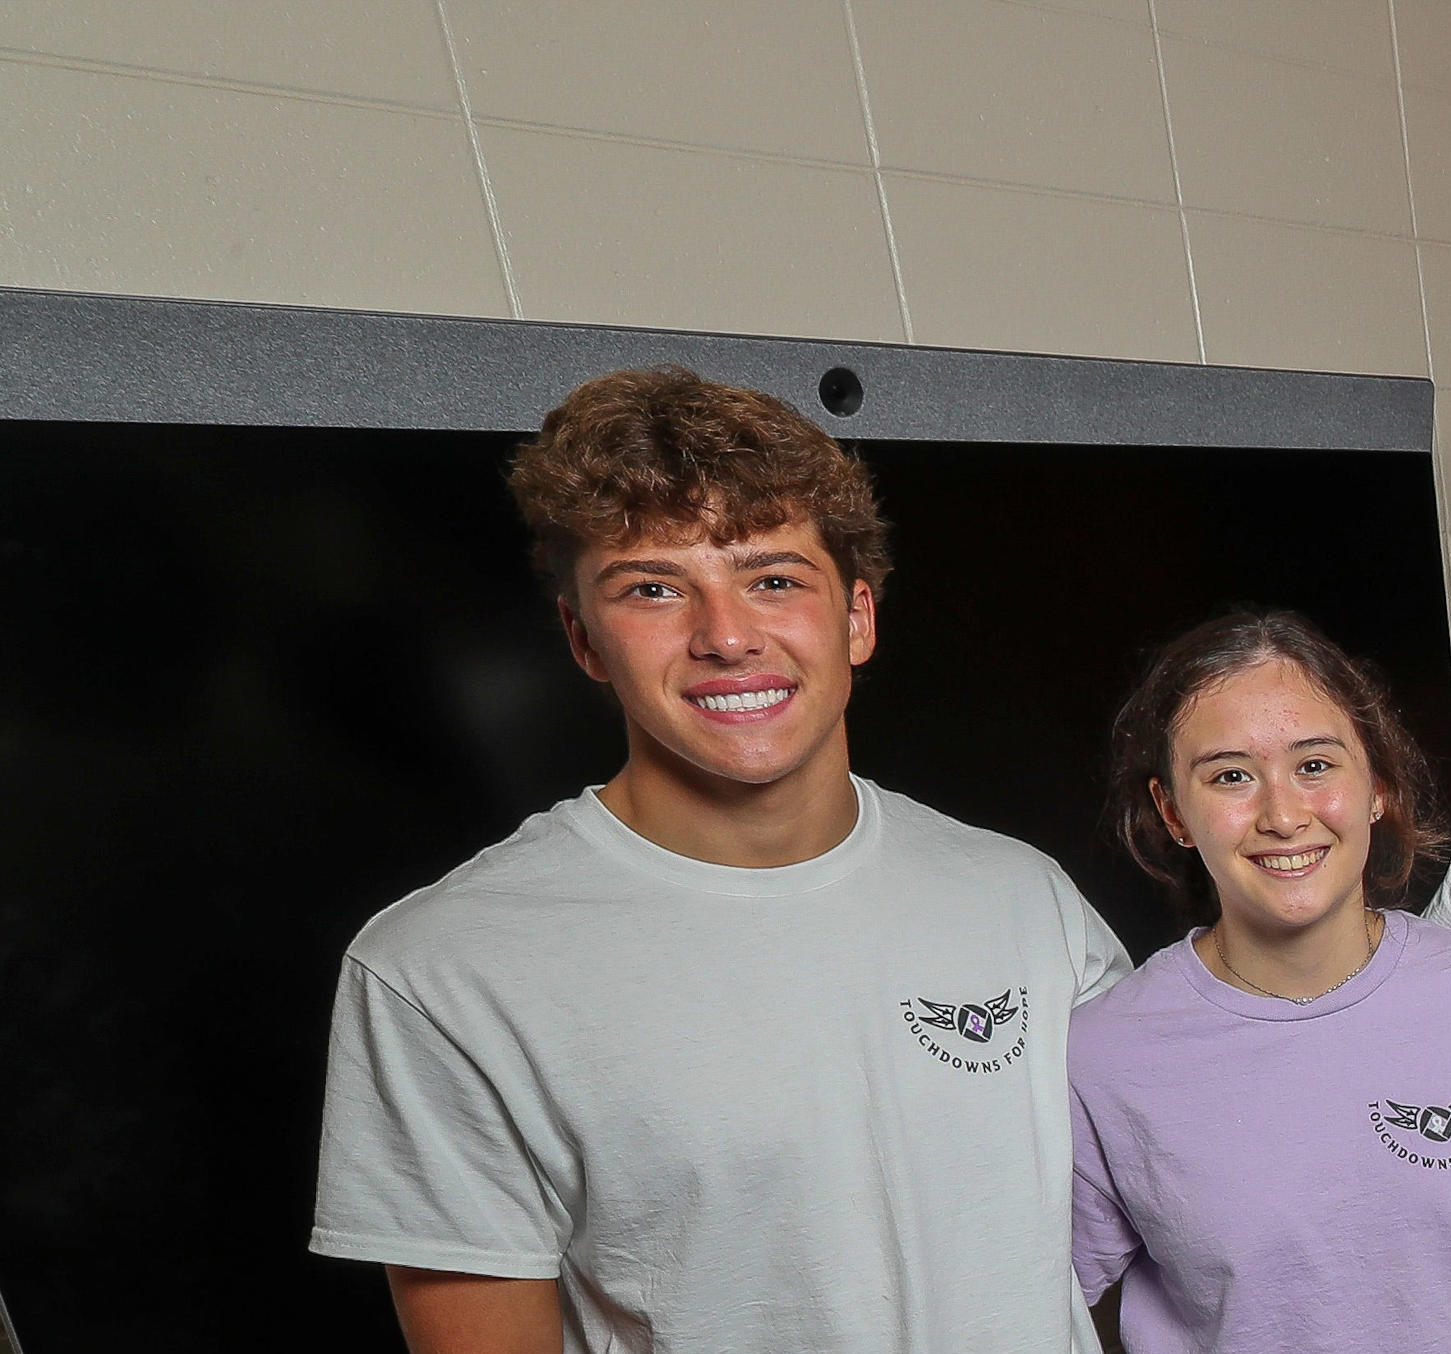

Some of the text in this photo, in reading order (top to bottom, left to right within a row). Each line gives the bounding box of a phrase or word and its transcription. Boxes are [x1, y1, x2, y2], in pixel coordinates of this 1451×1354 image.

[900, 986, 1028, 1073] TOUCHDOWNS FOR HOPE
